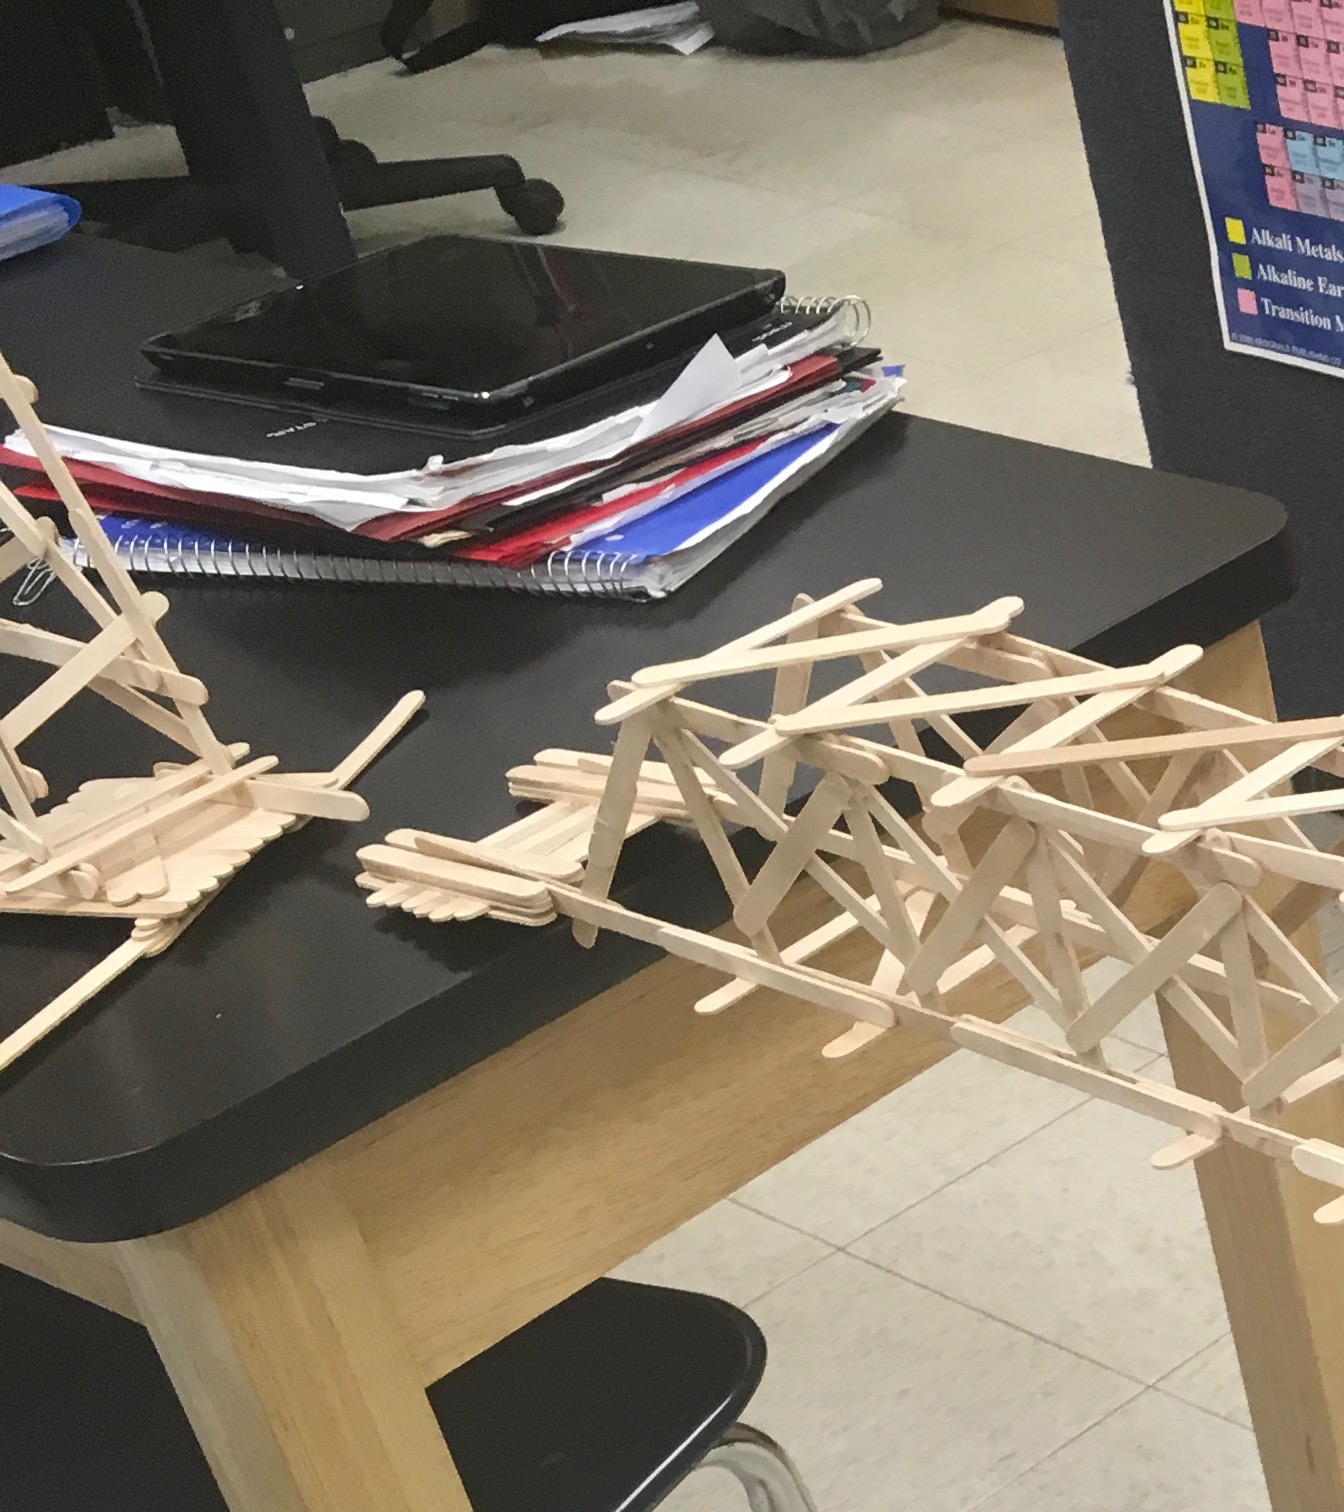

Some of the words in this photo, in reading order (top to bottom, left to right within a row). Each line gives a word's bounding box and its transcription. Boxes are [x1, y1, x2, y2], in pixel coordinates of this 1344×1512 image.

[1251, 227, 1292, 251] Alkali
[1296, 237, 1344, 264] Metals
[1257, 263, 1315, 292] Alkaline
[1261, 297, 1332, 330] Transition
